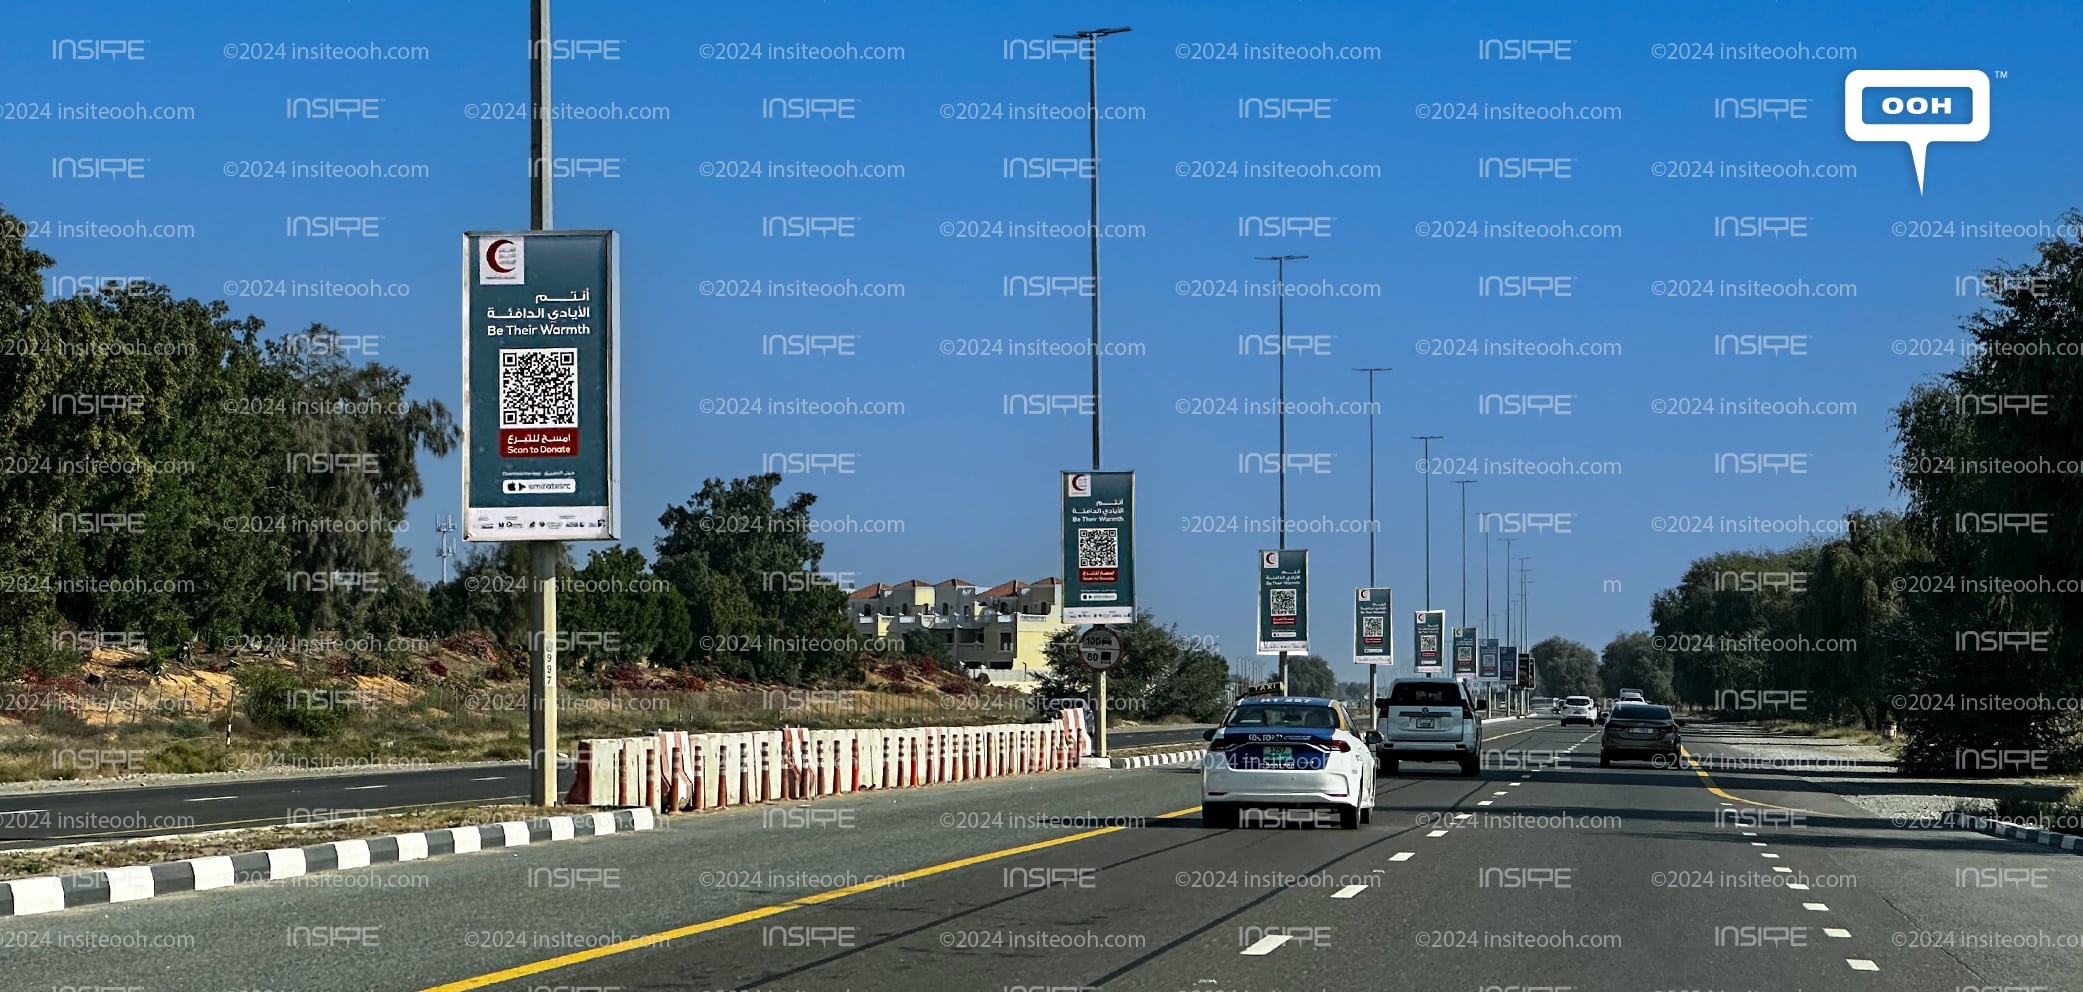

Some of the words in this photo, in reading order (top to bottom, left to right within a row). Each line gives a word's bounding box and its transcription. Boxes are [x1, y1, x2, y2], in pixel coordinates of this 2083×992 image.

[487, 307, 544, 319] الدافئة
[547, 306, 590, 323] الأيادي
[487, 325, 504, 336] Be
[506, 324, 538, 336] Their
[540, 323, 590, 335] Warmth
[507, 446, 529, 454] Scan
[530, 446, 539, 454] to
[540, 446, 571, 454] Donate
[1086, 637, 1101, 645] 100
[1086, 652, 1099, 661] 80
[1254, 683, 1277, 692] TAXI
